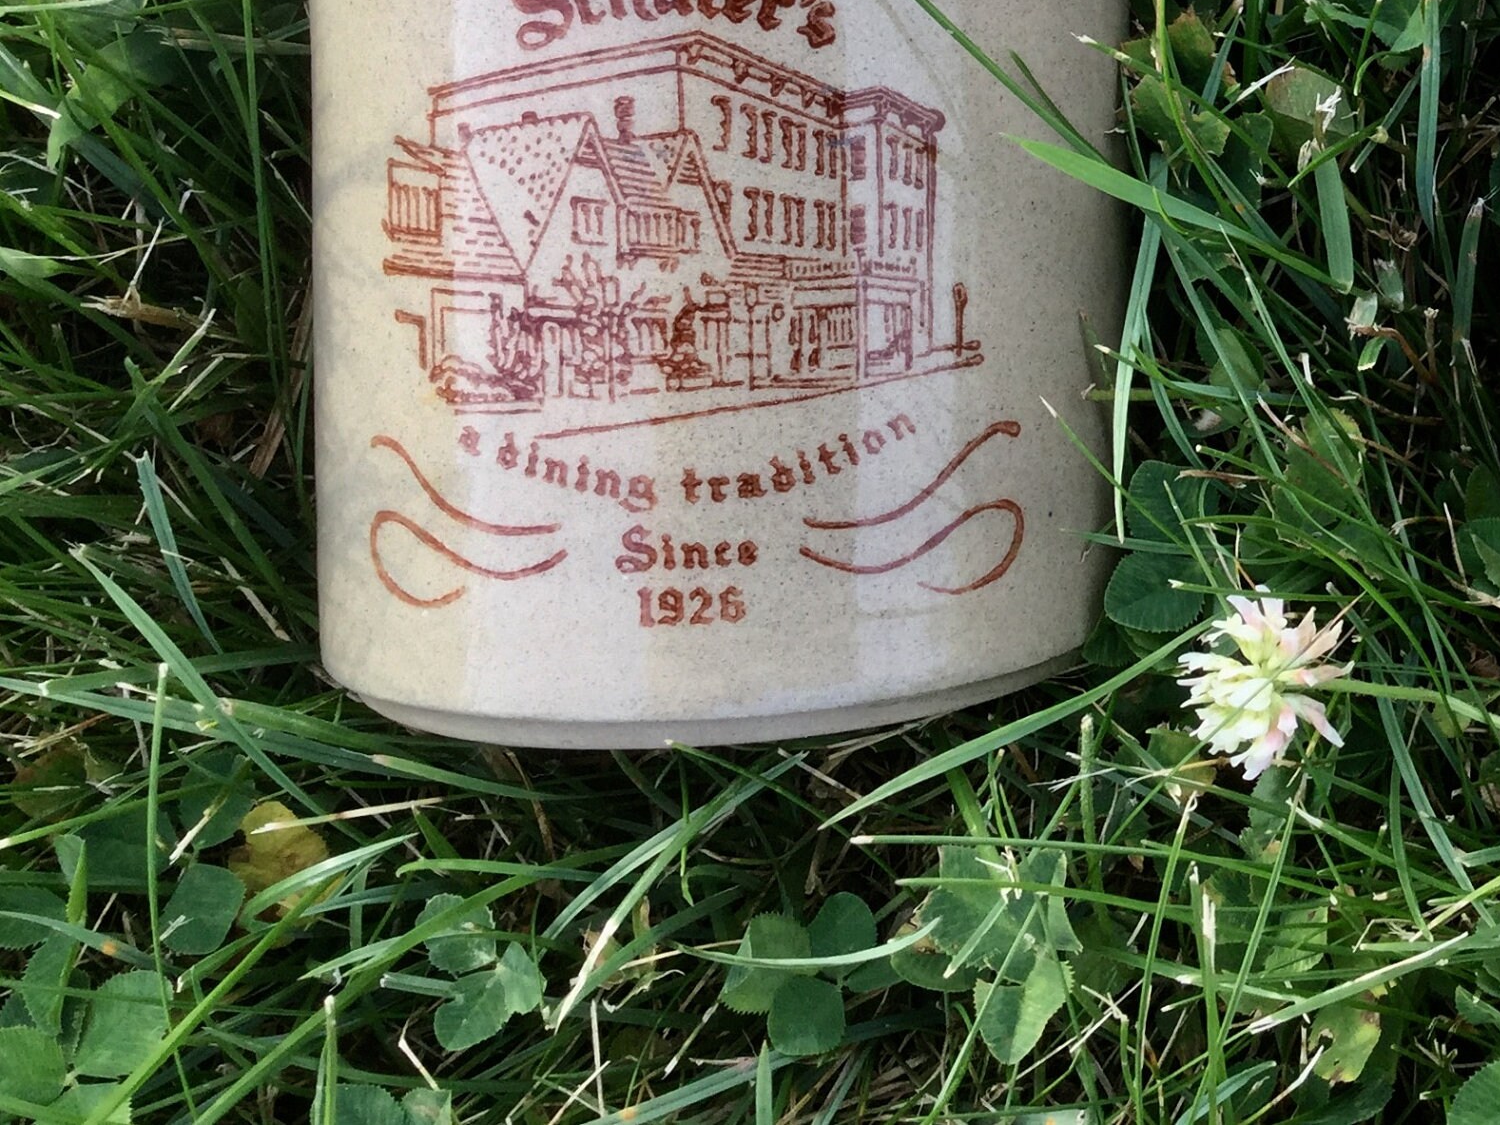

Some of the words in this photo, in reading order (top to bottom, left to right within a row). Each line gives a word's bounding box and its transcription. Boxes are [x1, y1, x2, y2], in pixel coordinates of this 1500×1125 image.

[458, 425, 481, 456] a
[496, 432, 658, 513] dining
[681, 412, 917, 505] tradition
[614, 524, 759, 573] Since
[637, 586, 747, 628] 1926
